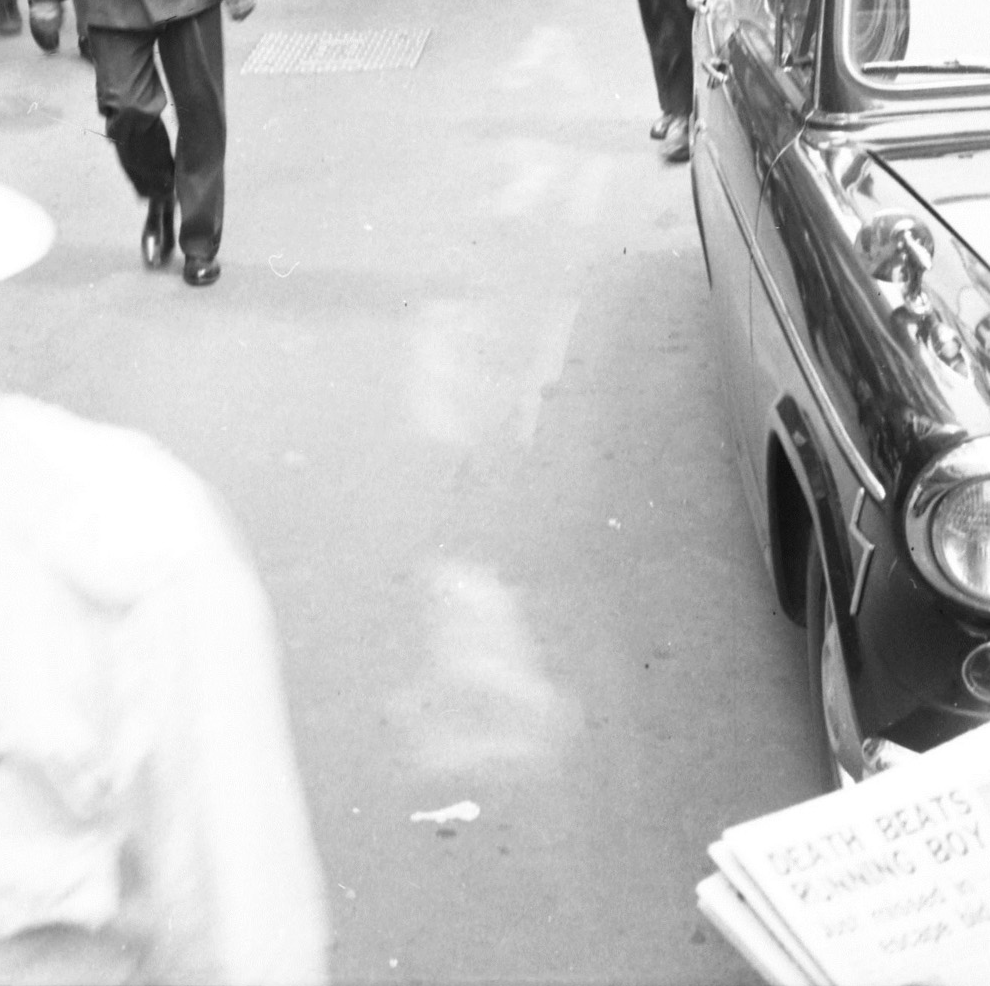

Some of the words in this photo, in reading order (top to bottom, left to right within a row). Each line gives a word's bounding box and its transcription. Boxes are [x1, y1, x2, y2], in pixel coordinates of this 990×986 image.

[767, 824, 868, 876] DEATH
[874, 789, 973, 843] BEATS
[925, 821, 986, 865] BOY
